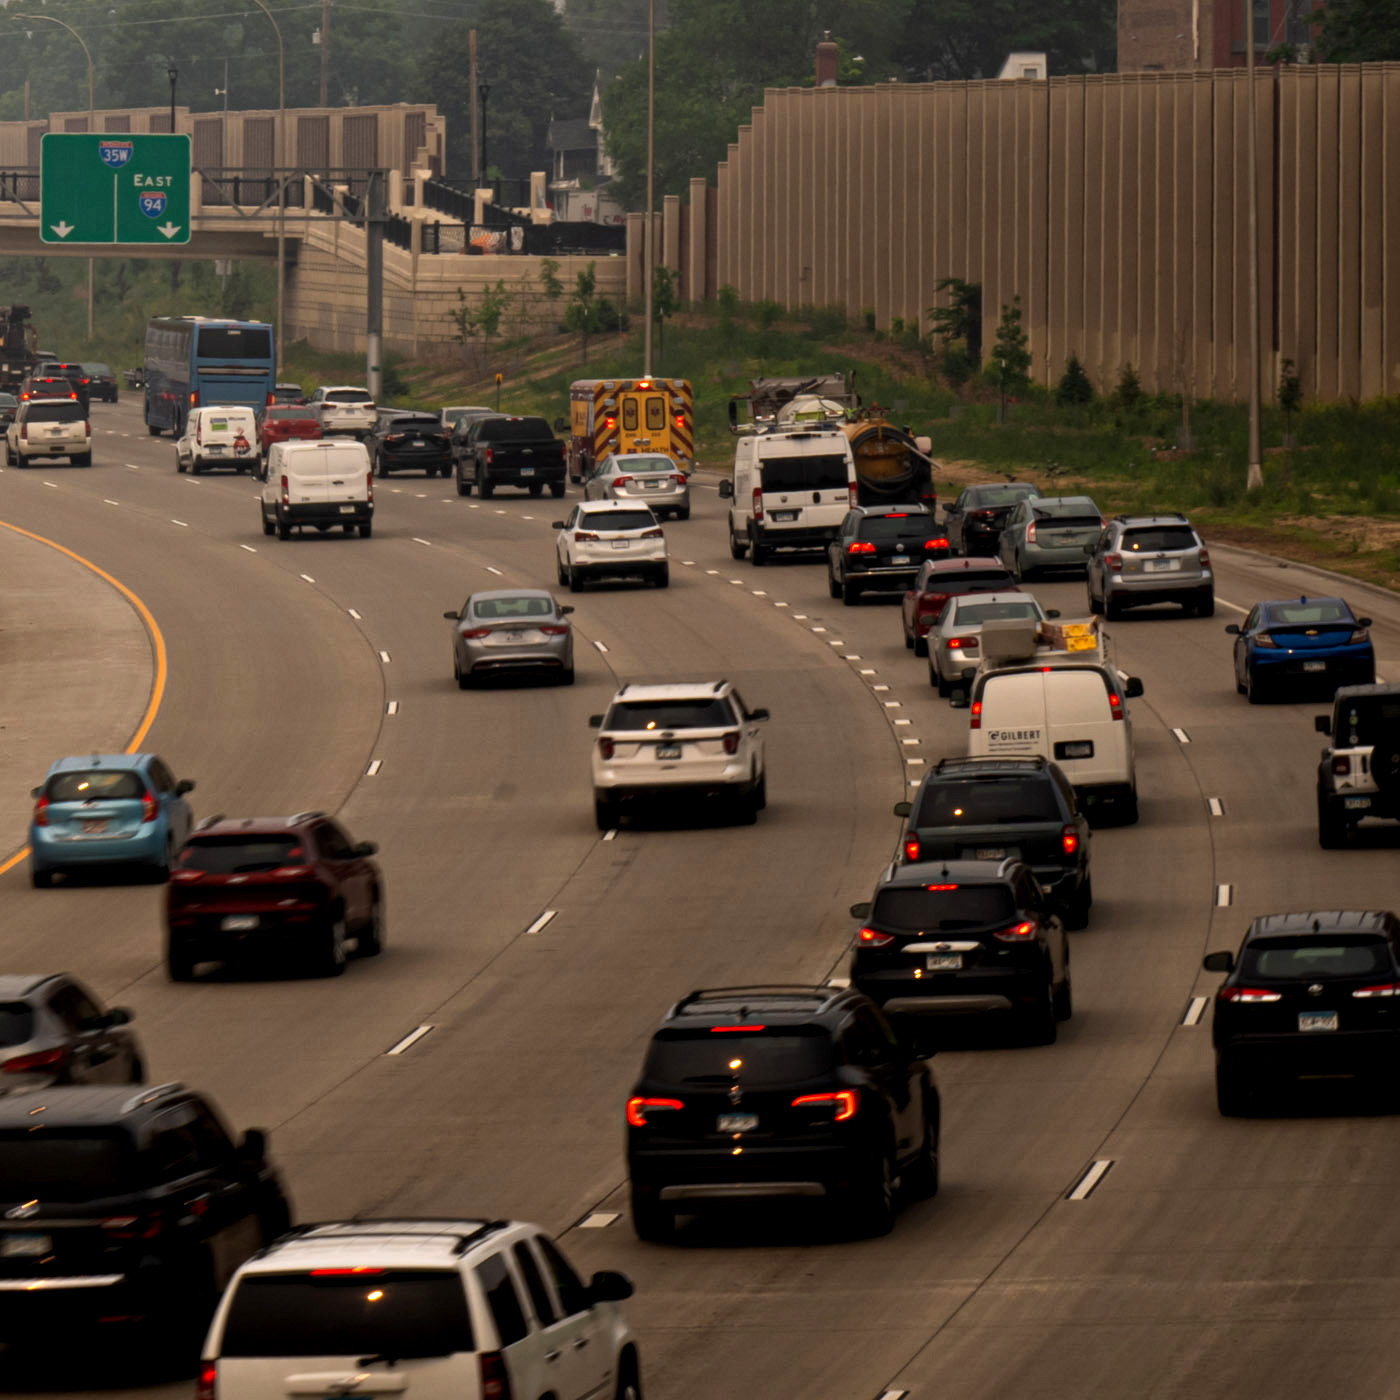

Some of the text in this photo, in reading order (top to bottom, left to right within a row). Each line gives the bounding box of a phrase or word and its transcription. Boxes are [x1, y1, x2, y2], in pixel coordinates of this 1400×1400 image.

[104, 149, 128, 162] 35W
[133, 174, 173, 187] EAST
[144, 198, 161, 211] 94
[1001, 730, 1040, 740] GILBERT
